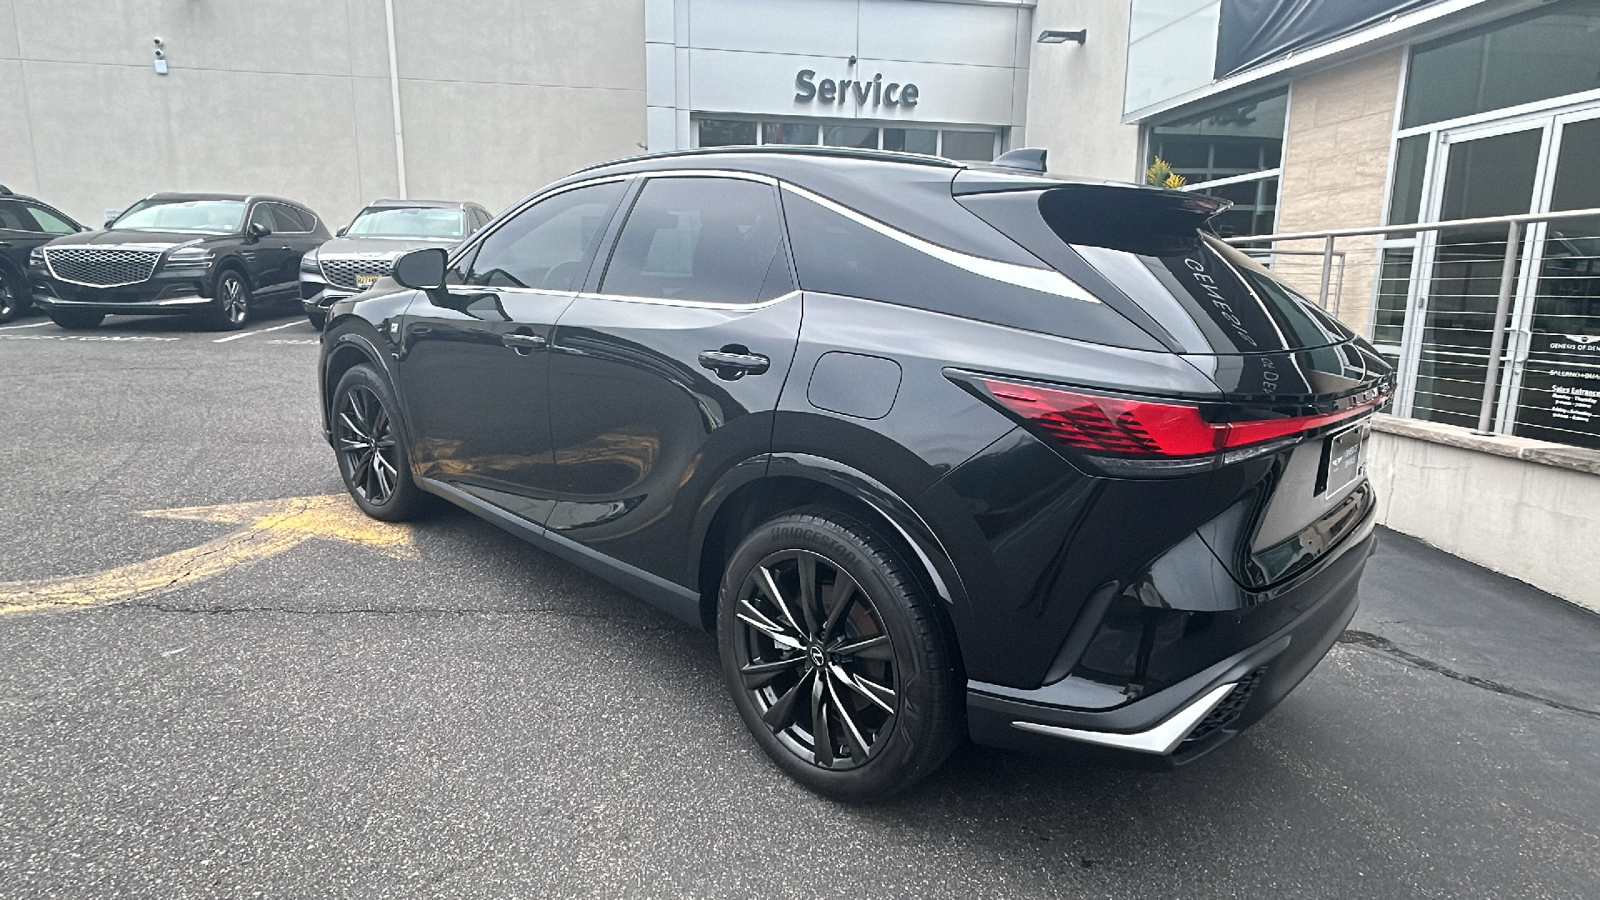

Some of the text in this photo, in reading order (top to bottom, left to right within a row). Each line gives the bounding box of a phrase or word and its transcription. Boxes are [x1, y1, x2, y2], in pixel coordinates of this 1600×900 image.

[794, 69, 919, 107] Service
[1549, 342, 1576, 350] GENESIS
[1551, 384, 1570, 394] Sales
